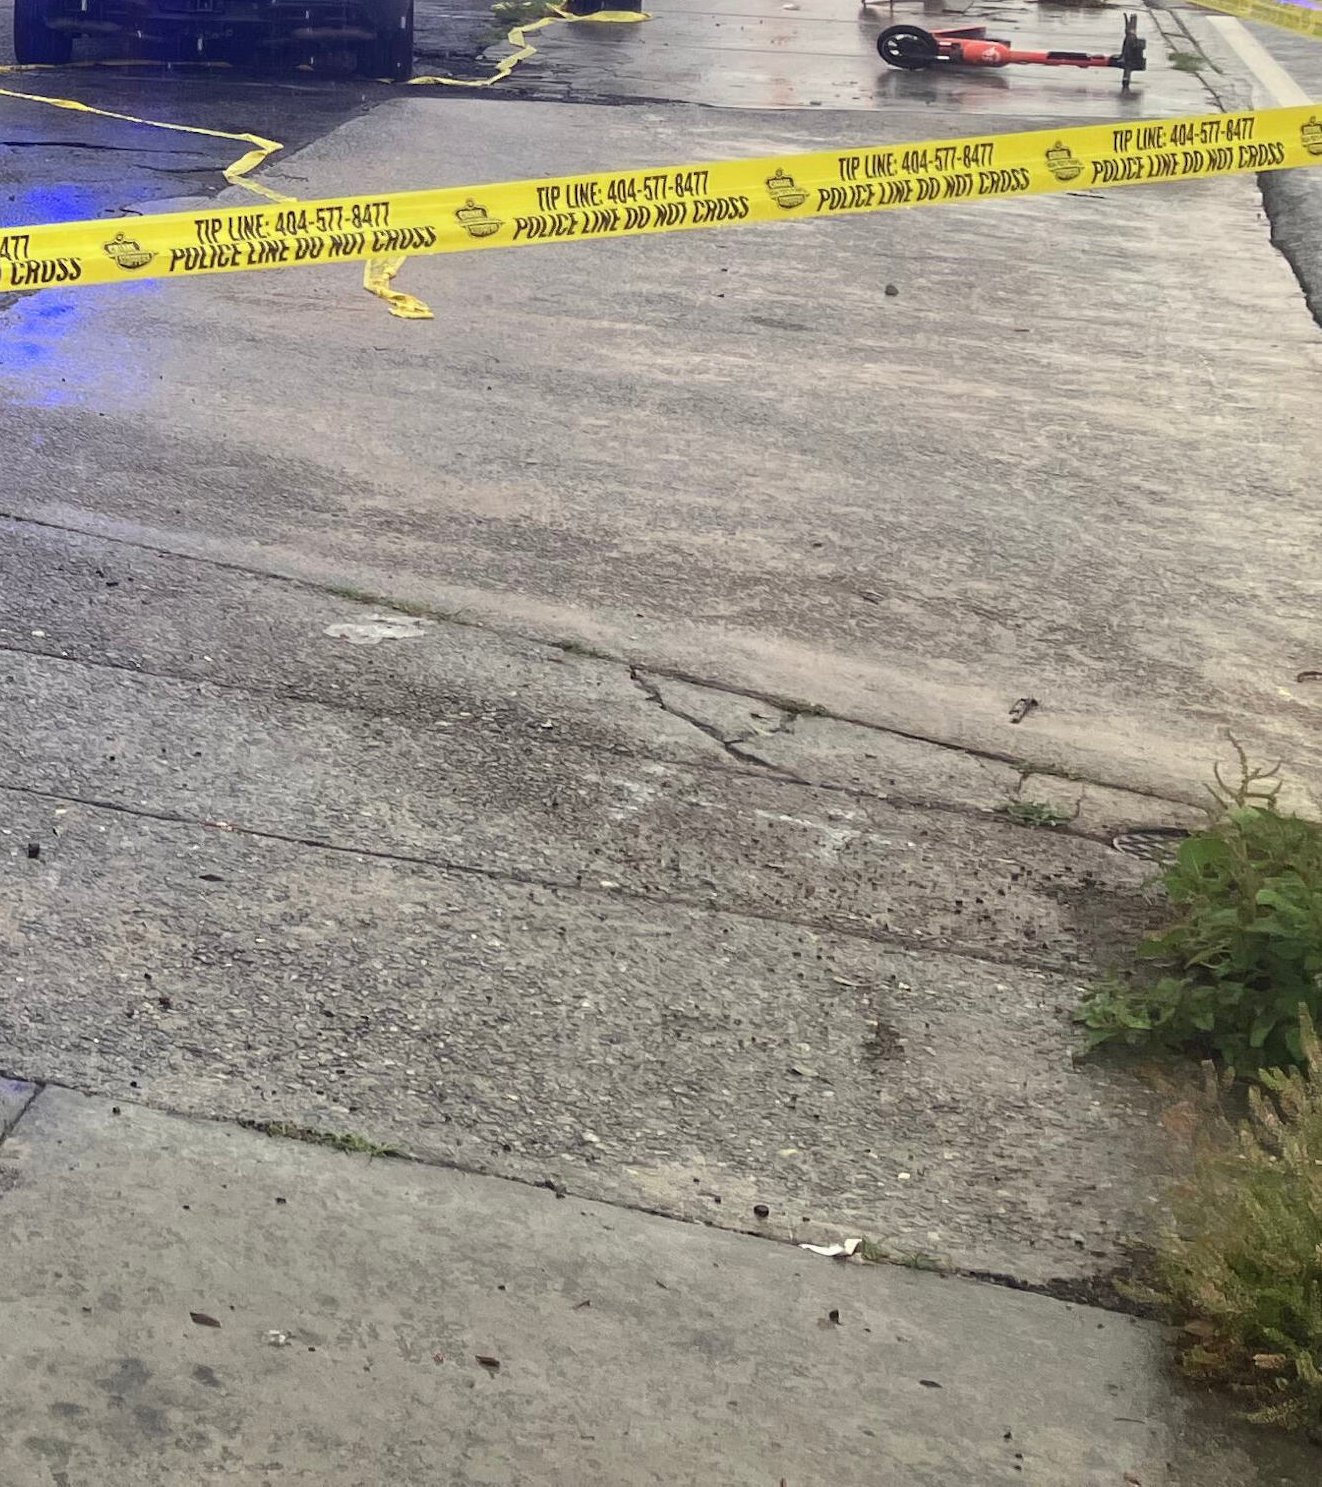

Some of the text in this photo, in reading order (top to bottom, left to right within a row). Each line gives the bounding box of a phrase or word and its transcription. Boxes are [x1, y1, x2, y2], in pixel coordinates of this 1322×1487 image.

[1112, 116, 1256, 155] TIP LINE: 404-577-8477
[837, 141, 996, 182] TIP LINE: 404-577-8477
[1091, 154, 1146, 185] POLICE
[1147, 150, 1182, 179] LINE
[1182, 147, 1207, 175] DO
[1206, 144, 1235, 172] NOT
[1237, 140, 1286, 169] CROSS
[536, 170, 710, 212] TIP LINE: 404-577-8477
[816, 182, 876, 212] POLICE
[877, 178, 913, 206] LINE
[915, 175, 942, 202] DO
[942, 172, 975, 199] NOT
[977, 166, 1032, 195] CROSS
[194, 201, 391, 246] TIP LINE: 404-577-8477
[512, 211, 580, 241] POLICE
[580, 207, 622, 235] LINE
[623, 204, 651, 231] DO
[653, 201, 689, 228] NOT
[691, 195, 751, 223] CROSS
[169, 242, 243, 272] POLICE
[246, 237, 291, 265] LINE
[294, 235, 324, 261] DO
[327, 231, 367, 259] NOT
[370, 224, 438, 253] CROSS
[9, 256, 83, 286] CROSS
